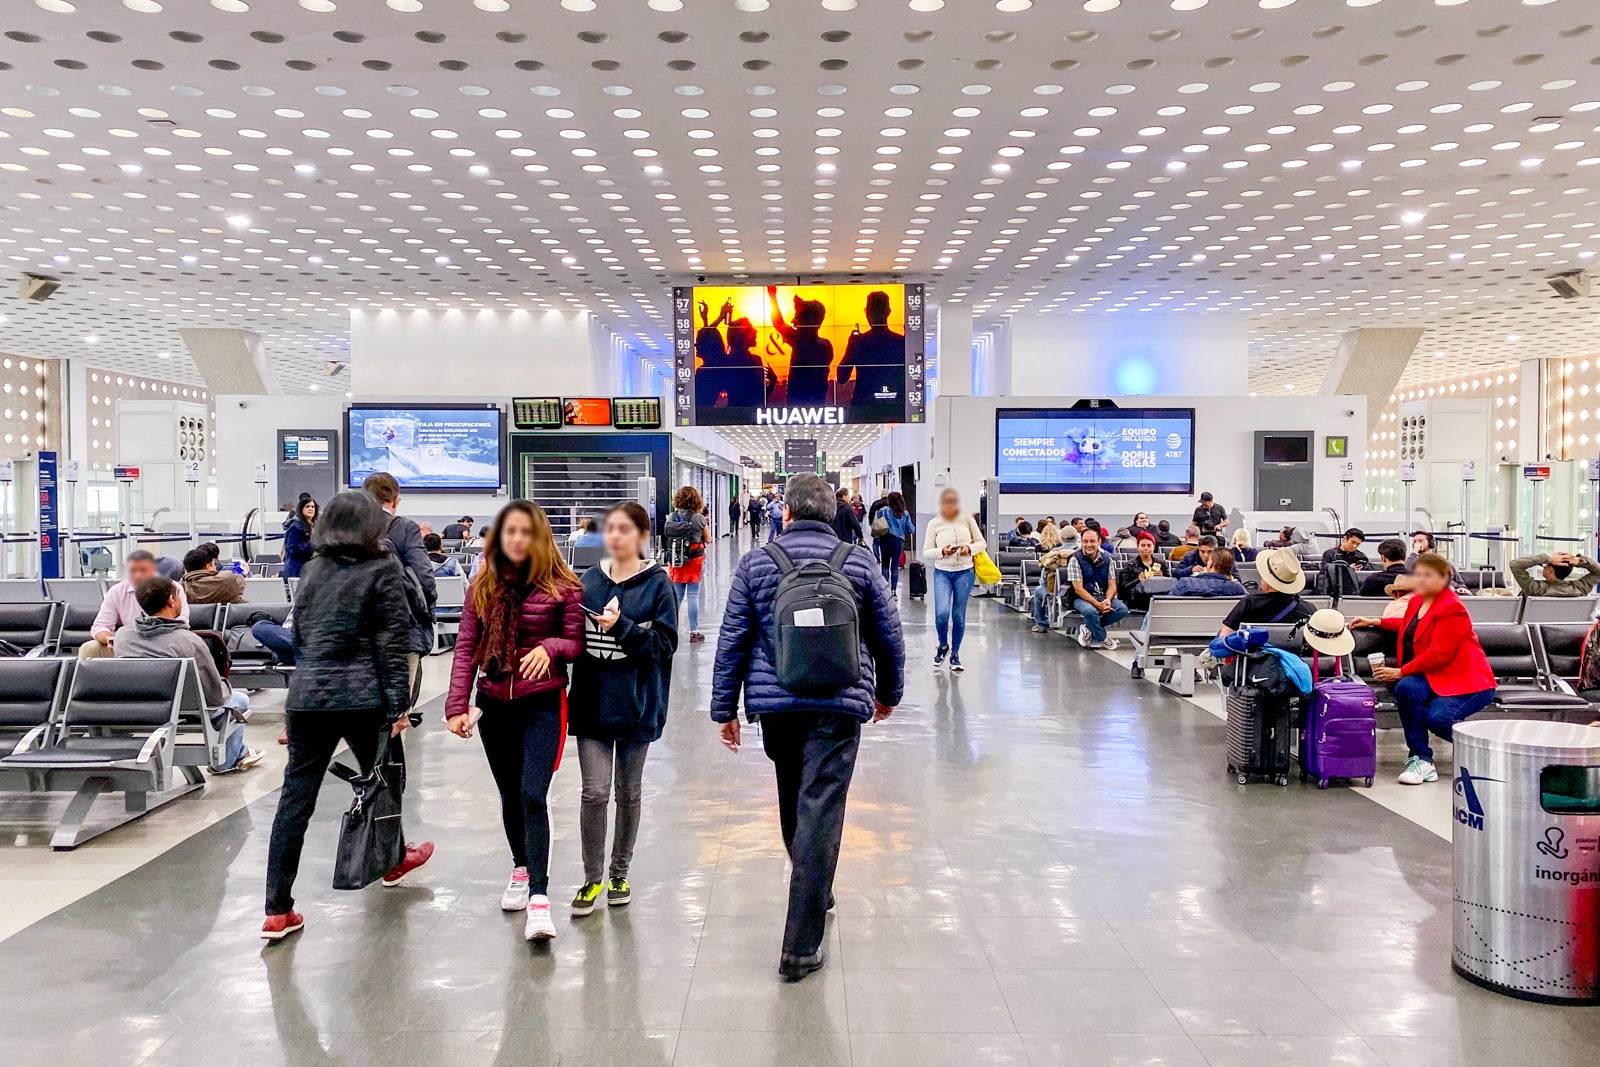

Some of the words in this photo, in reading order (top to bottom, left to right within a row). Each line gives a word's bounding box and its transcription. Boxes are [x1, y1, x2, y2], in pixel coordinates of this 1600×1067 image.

[676, 298, 690, 308] 57
[908, 295, 921, 305] 56
[677, 318, 690, 329] 58
[908, 315, 921, 325] 55
[677, 339, 691, 349] 59
[766, 333, 785, 355] &
[678, 368, 691, 378] 60
[908, 364, 922, 374] 54
[678, 395, 691, 405] 61
[908, 391, 922, 401] 53
[756, 406, 844, 424] HUAWEI
[1122, 428, 1157, 436] EQUIPO
[1014, 437, 1056, 446] SIEMPRE
[1002, 448, 1067, 456] CONECTADOS
[1122, 450, 1157, 459] DOBLE
[72, 462, 78, 470] 3
[192, 462, 199, 470] 2
[1122, 459, 1157, 468] GIGAS
[1453, 805, 1484, 831] ICM
